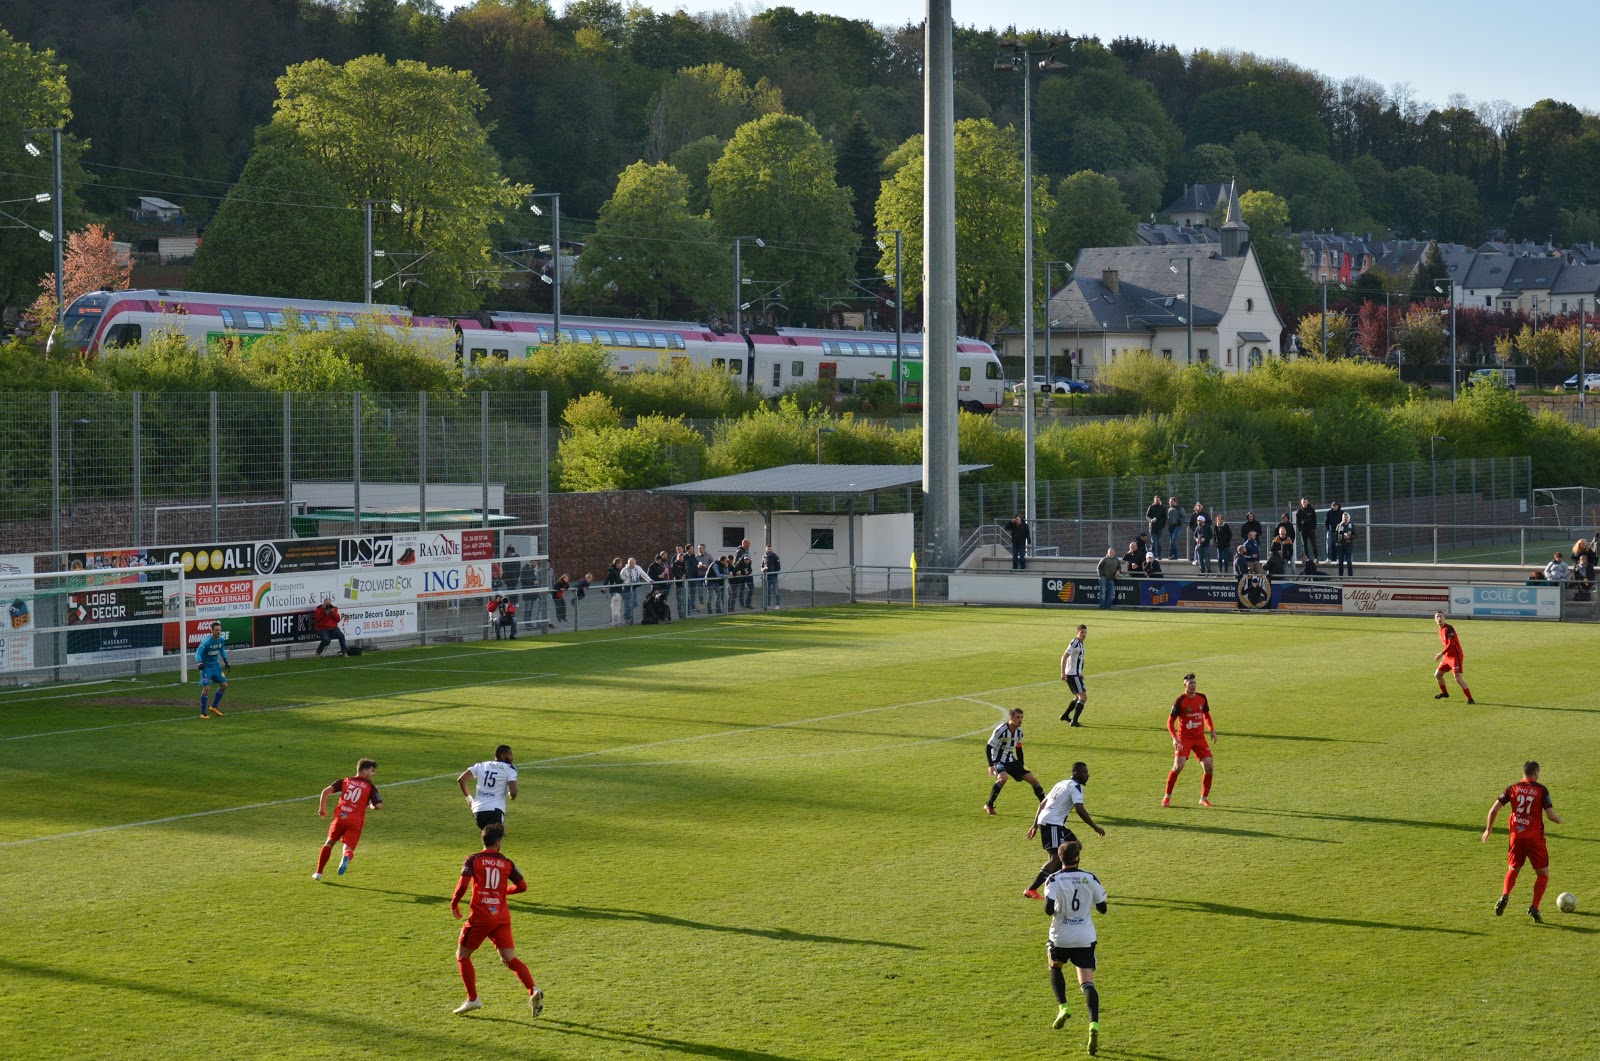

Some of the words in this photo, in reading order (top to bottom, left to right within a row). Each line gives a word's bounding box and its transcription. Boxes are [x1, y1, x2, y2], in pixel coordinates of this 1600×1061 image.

[273, 582, 304, 592] Transports
[424, 569, 459, 592] ING
[1047, 580, 1063, 591] Q8
[198, 584, 222, 595] SNACK
[230, 583, 250, 592] SHOP
[1344, 590, 1371, 600] Aldo
[1372, 590, 1391, 601] Bei
[86, 593, 116, 606] LOGIS
[266, 594, 306, 607] Micolino
[309, 593, 316, 604] &
[1152, 592, 1169, 604] BEI
[92, 606, 126, 619] DECOR
[1358, 601, 1377, 611] Fils
[365, 610, 383, 618] Décors
[385, 609, 405, 618] Gaspar
[270, 616, 294, 634] DIFF
[484, 771, 497, 788] 15
[344, 784, 362, 803] 50
[1516, 794, 1534, 814] 27
[485, 867, 500, 889] 10
[1071, 889, 1080, 911] 6
